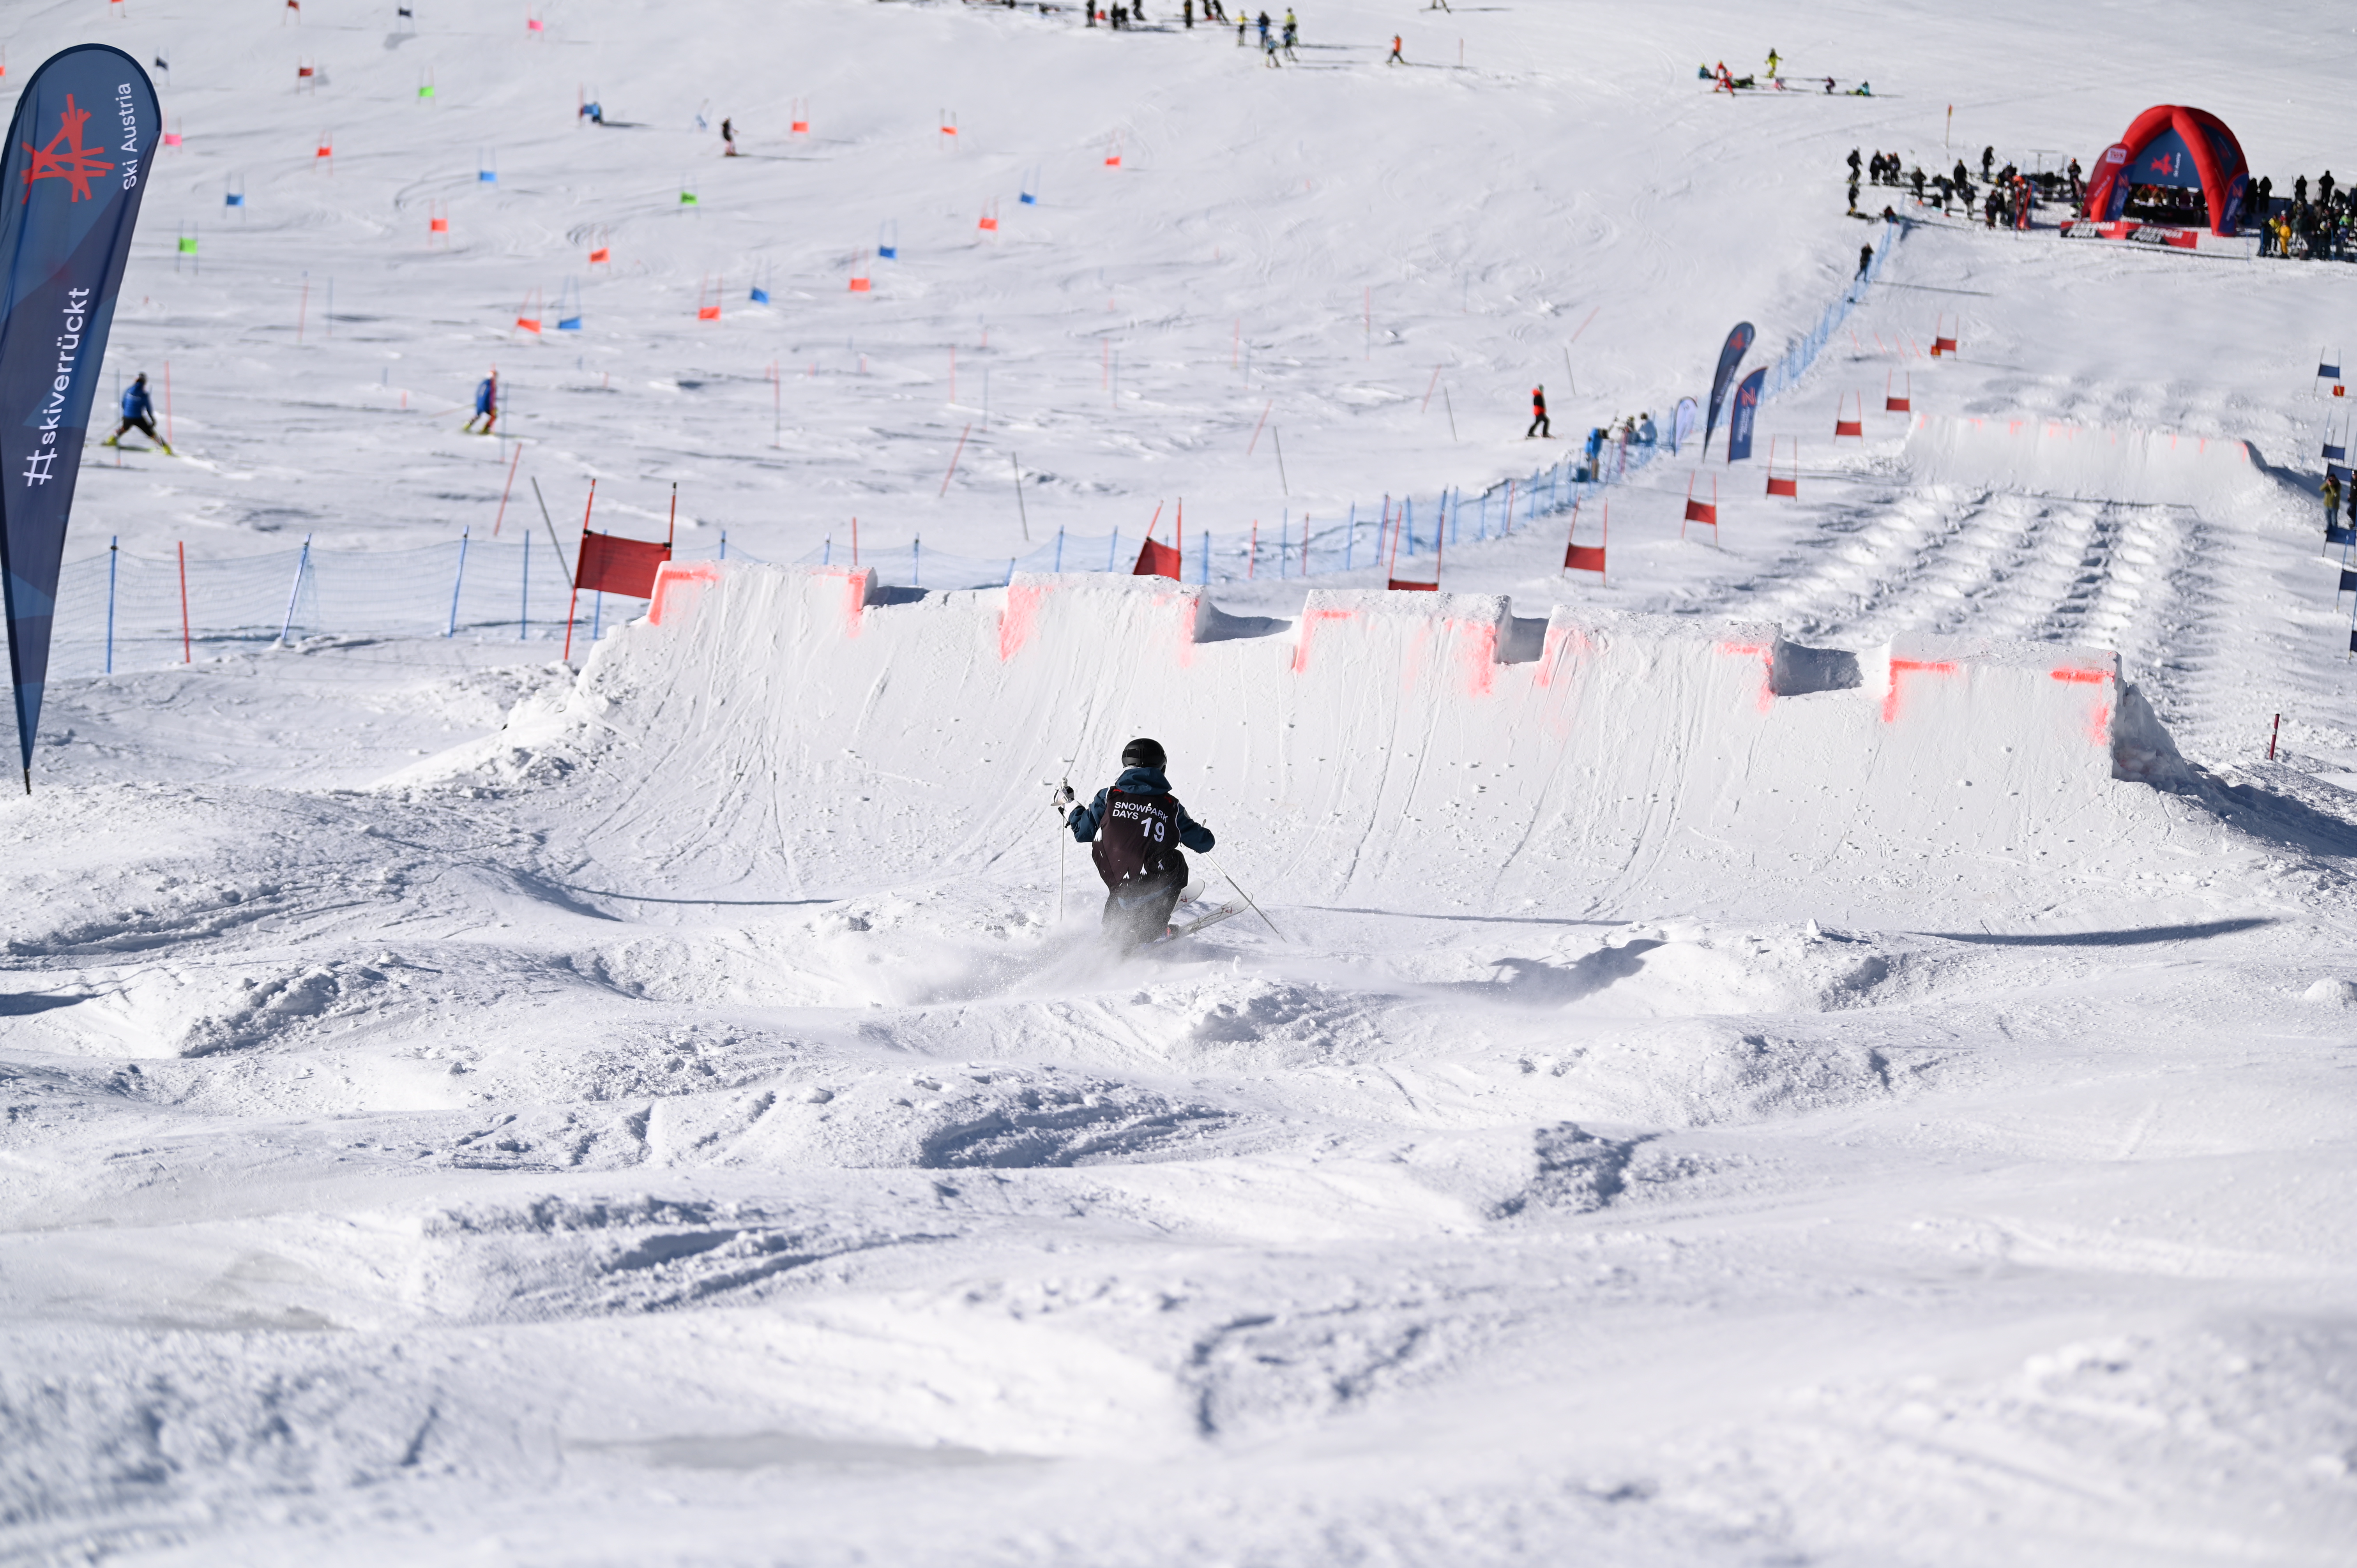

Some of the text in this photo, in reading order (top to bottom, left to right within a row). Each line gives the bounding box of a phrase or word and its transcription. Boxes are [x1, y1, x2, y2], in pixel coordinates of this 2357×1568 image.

[115, 83, 138, 190] Ski Austria
[22, 288, 90, 487] #skiverrückt
[1112, 809, 1139, 820] DAYS
[1114, 802, 1168, 823] SNOWPARK
[1141, 817, 1164, 842] 19
